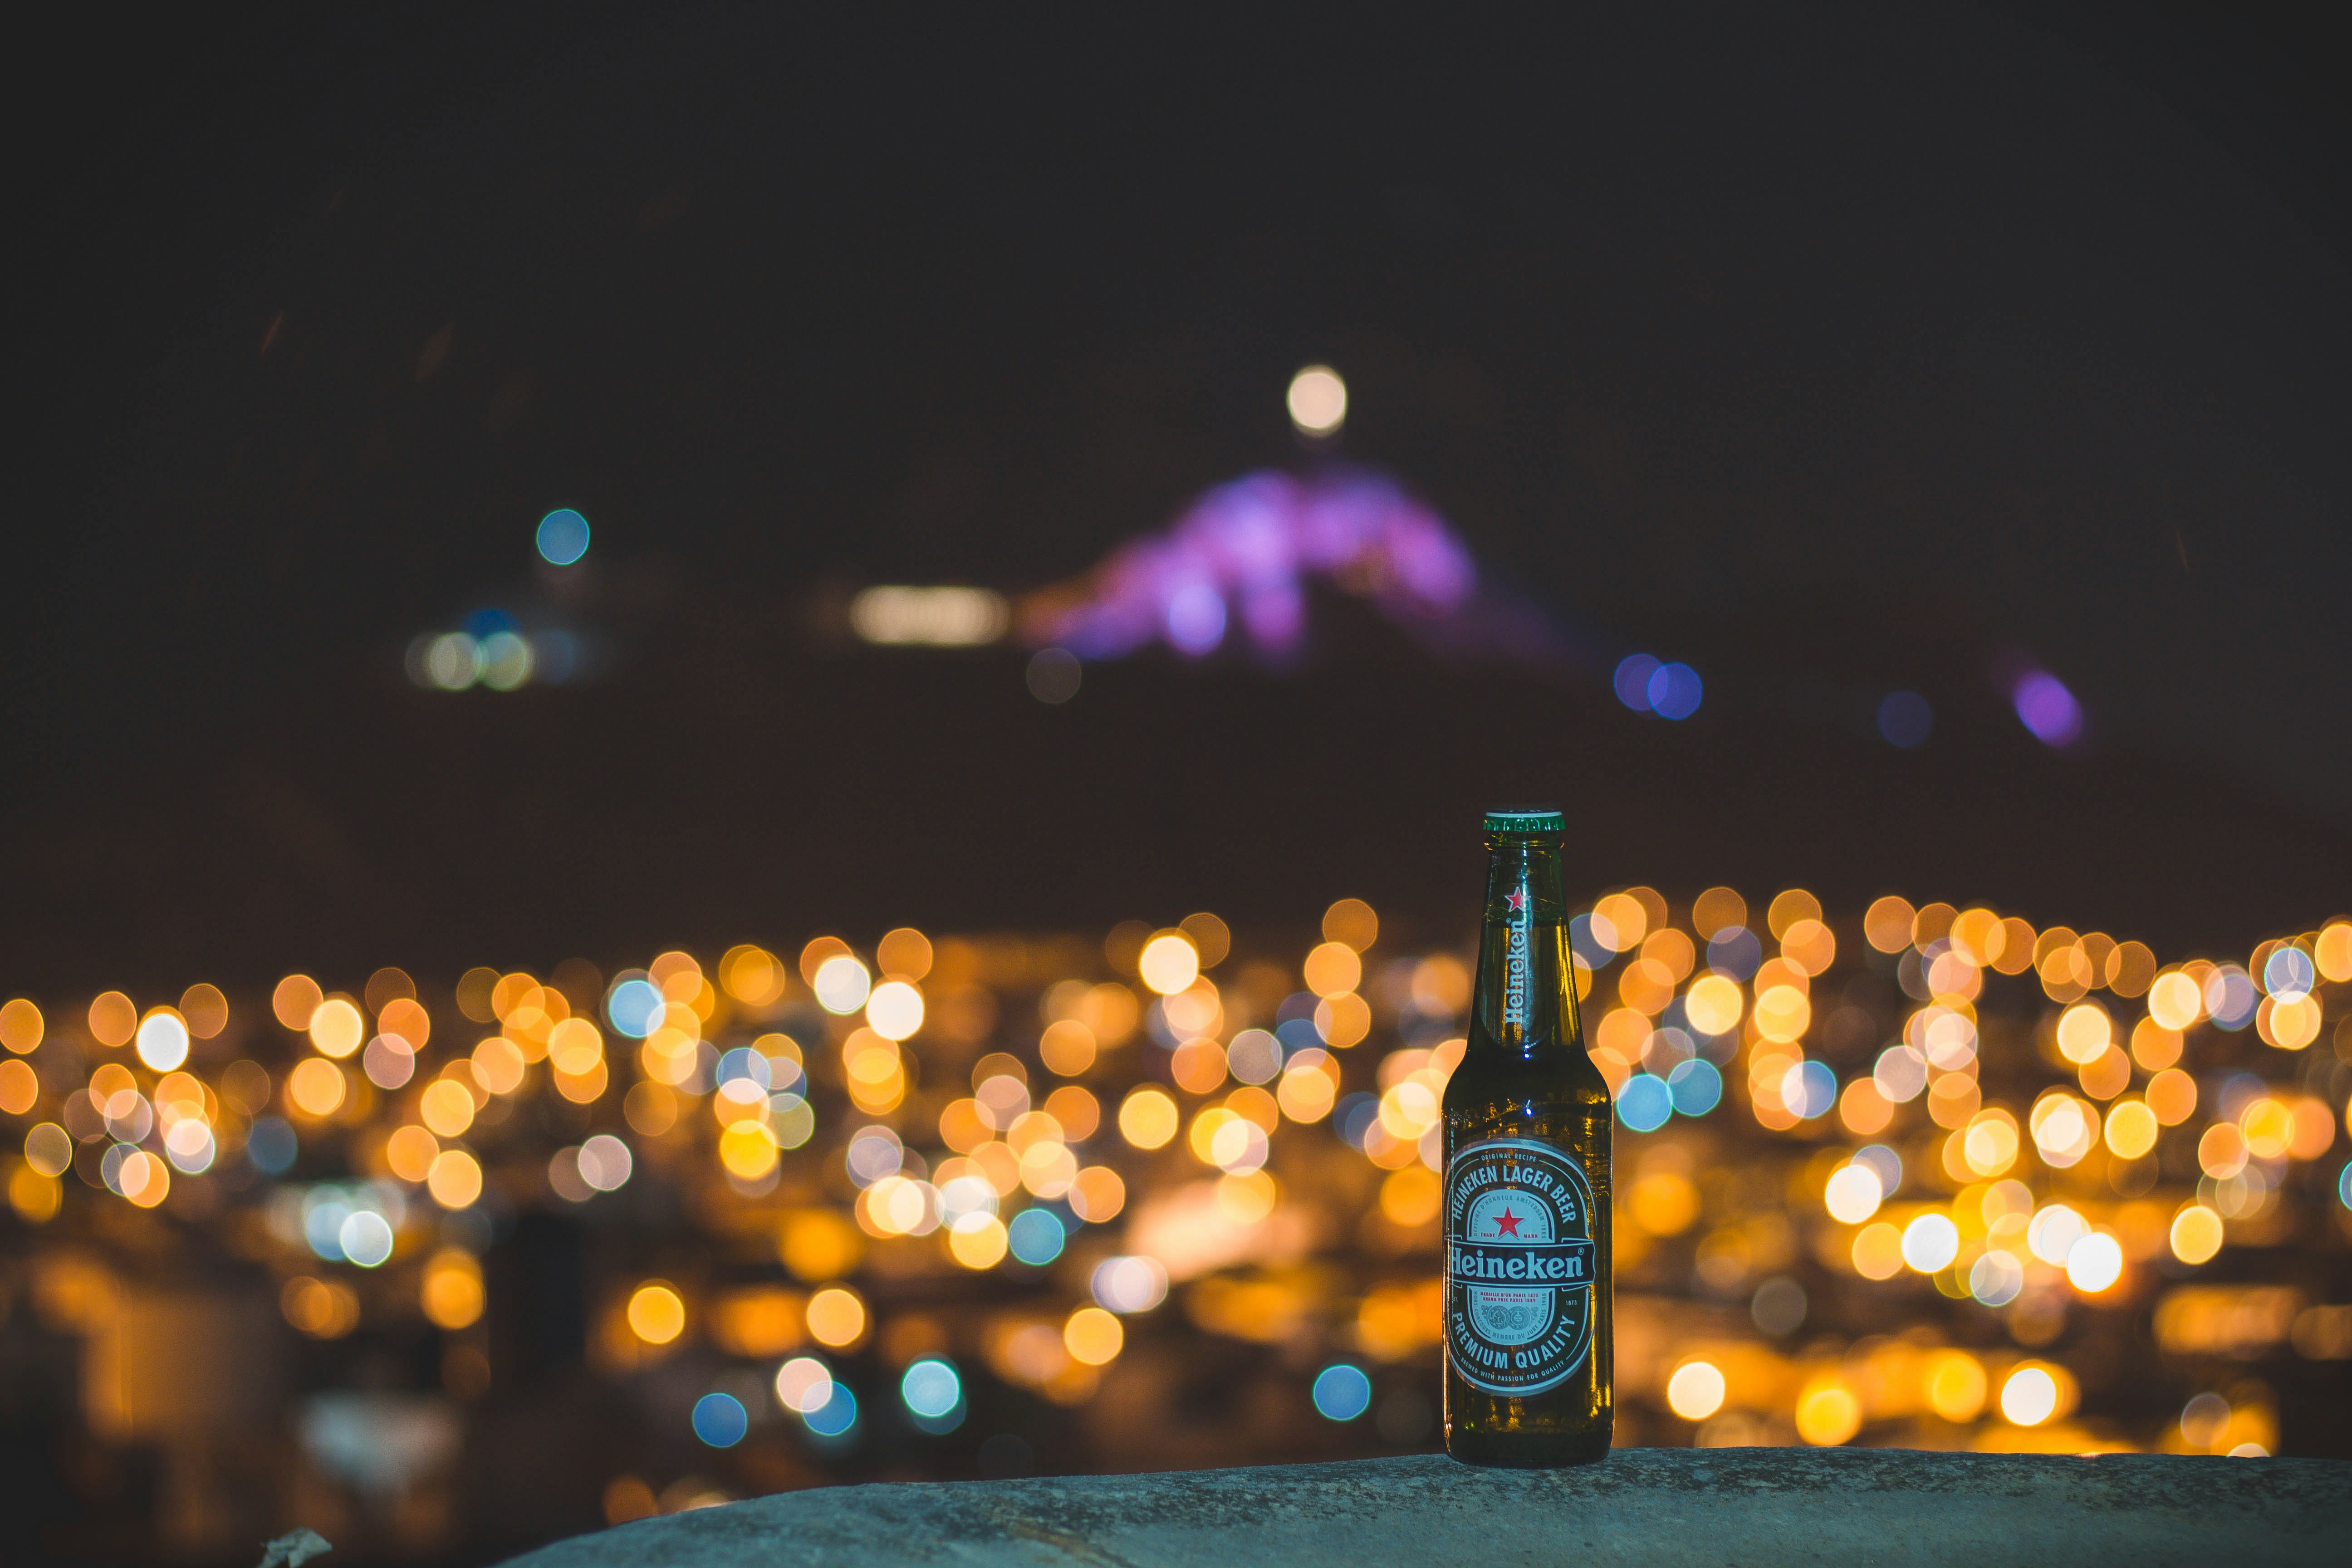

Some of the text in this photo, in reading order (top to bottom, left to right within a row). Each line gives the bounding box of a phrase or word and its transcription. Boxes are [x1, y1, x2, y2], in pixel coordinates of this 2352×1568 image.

[1481, 1153, 1536, 1162] ORIGINAL RECIPE
[1453, 1165, 1576, 1224] HEINEKEN LAGER BEER
[1480, 1195, 1513, 1209] D'HONNEUR
[1516, 1196, 1545, 1221] AMSTERDAM
[1475, 1308, 1491, 1334] CONCOURS
[1527, 1325, 1539, 1336] JURY
[1452, 1312, 1575, 1369] PREMIUM QUALITY
[1461, 1357, 1478, 1373] BREWED
[1480, 1370, 1494, 1380] WITH
[1541, 1360, 1564, 1376] QUALITY
